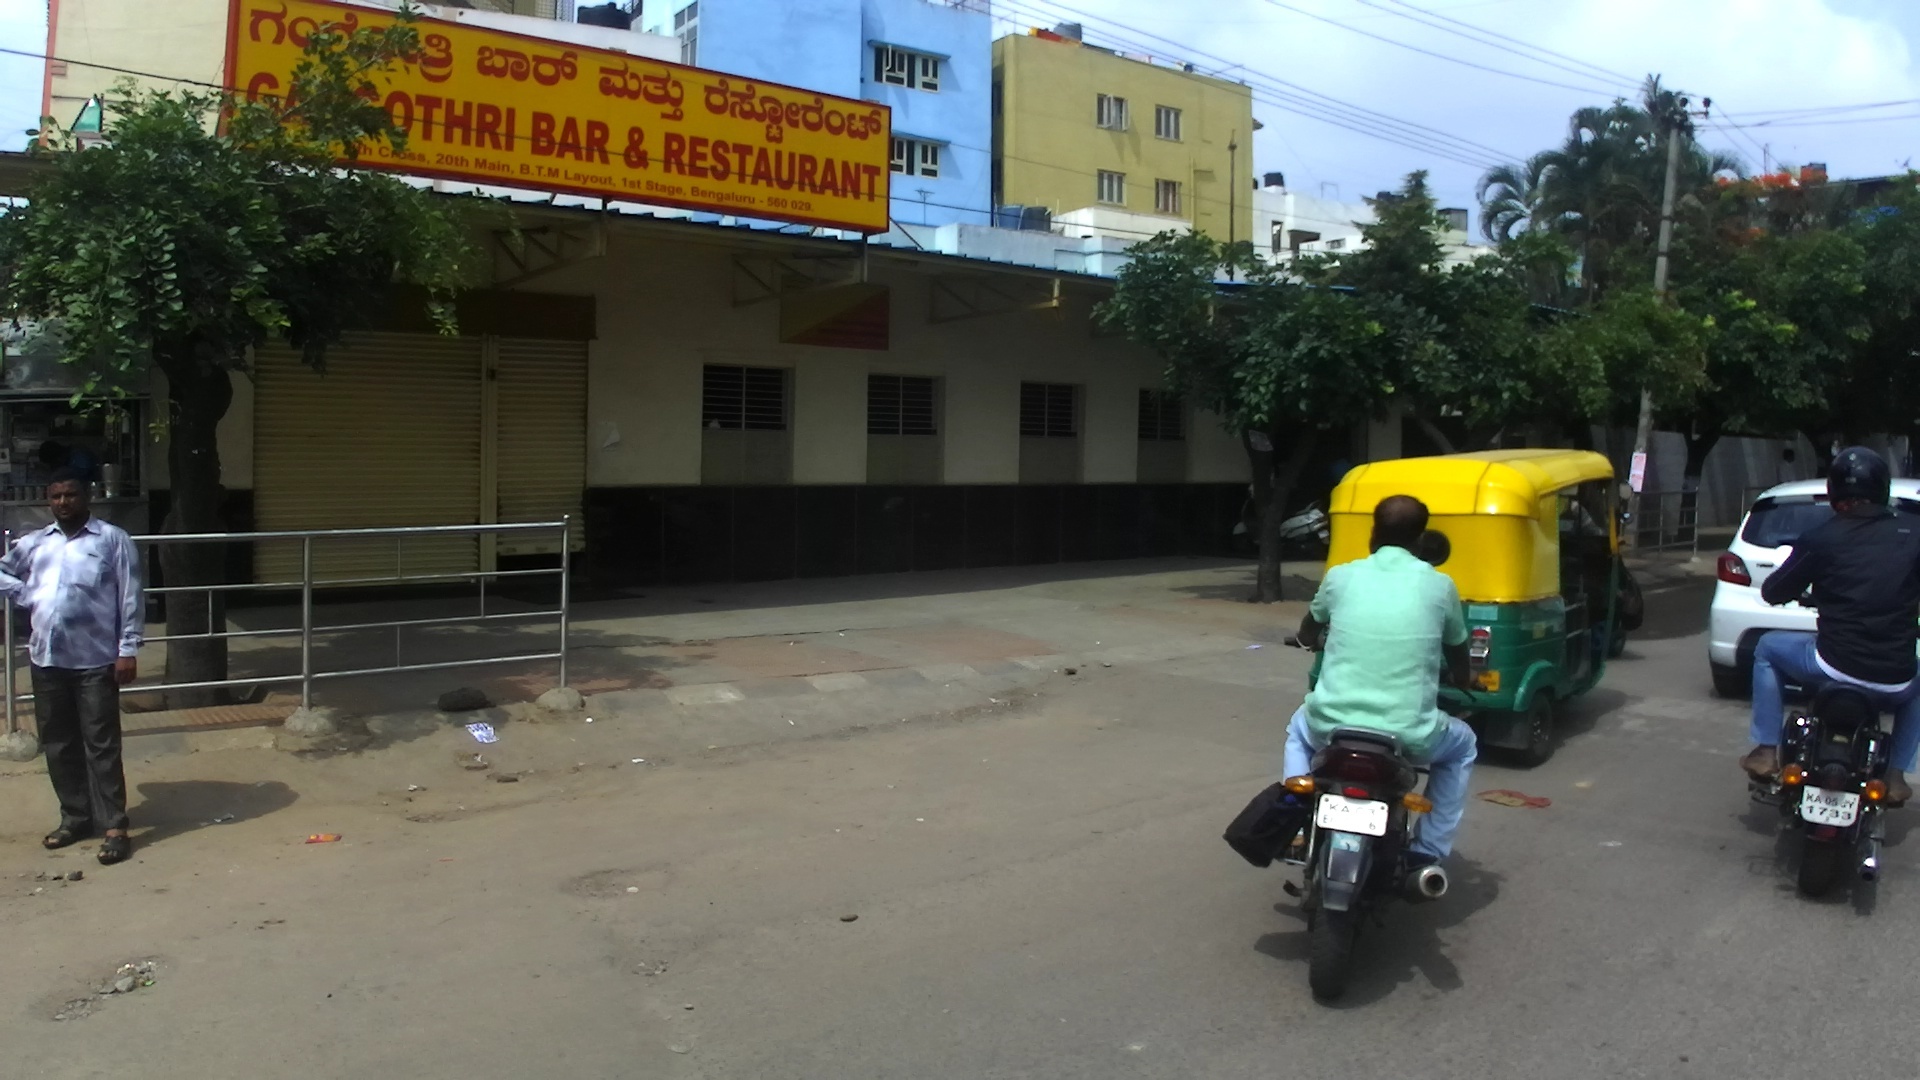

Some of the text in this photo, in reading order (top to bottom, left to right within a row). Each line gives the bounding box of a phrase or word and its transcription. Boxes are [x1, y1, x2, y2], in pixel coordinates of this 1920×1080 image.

[247, 72, 880, 202] GOTHRI BAR & RESTAURANT
[477, 45, 577, 86] ಬಾರ್
[599, 60, 684, 122] ಮತ್ತು
[704, 78, 881, 143] ರೆಸ್ಟೋರೆಂಟ್
[436, 153, 469, 168] 20th
[474, 157, 515, 175] Main,
[520, 165, 559, 179] B.T.M
[564, 169, 616, 187] Layout,
[622, 177, 641, 189] 1st
[645, 180, 686, 197] Stage,
[691, 186, 755, 204] Bengaluru
[767, 196, 787, 209] 560
